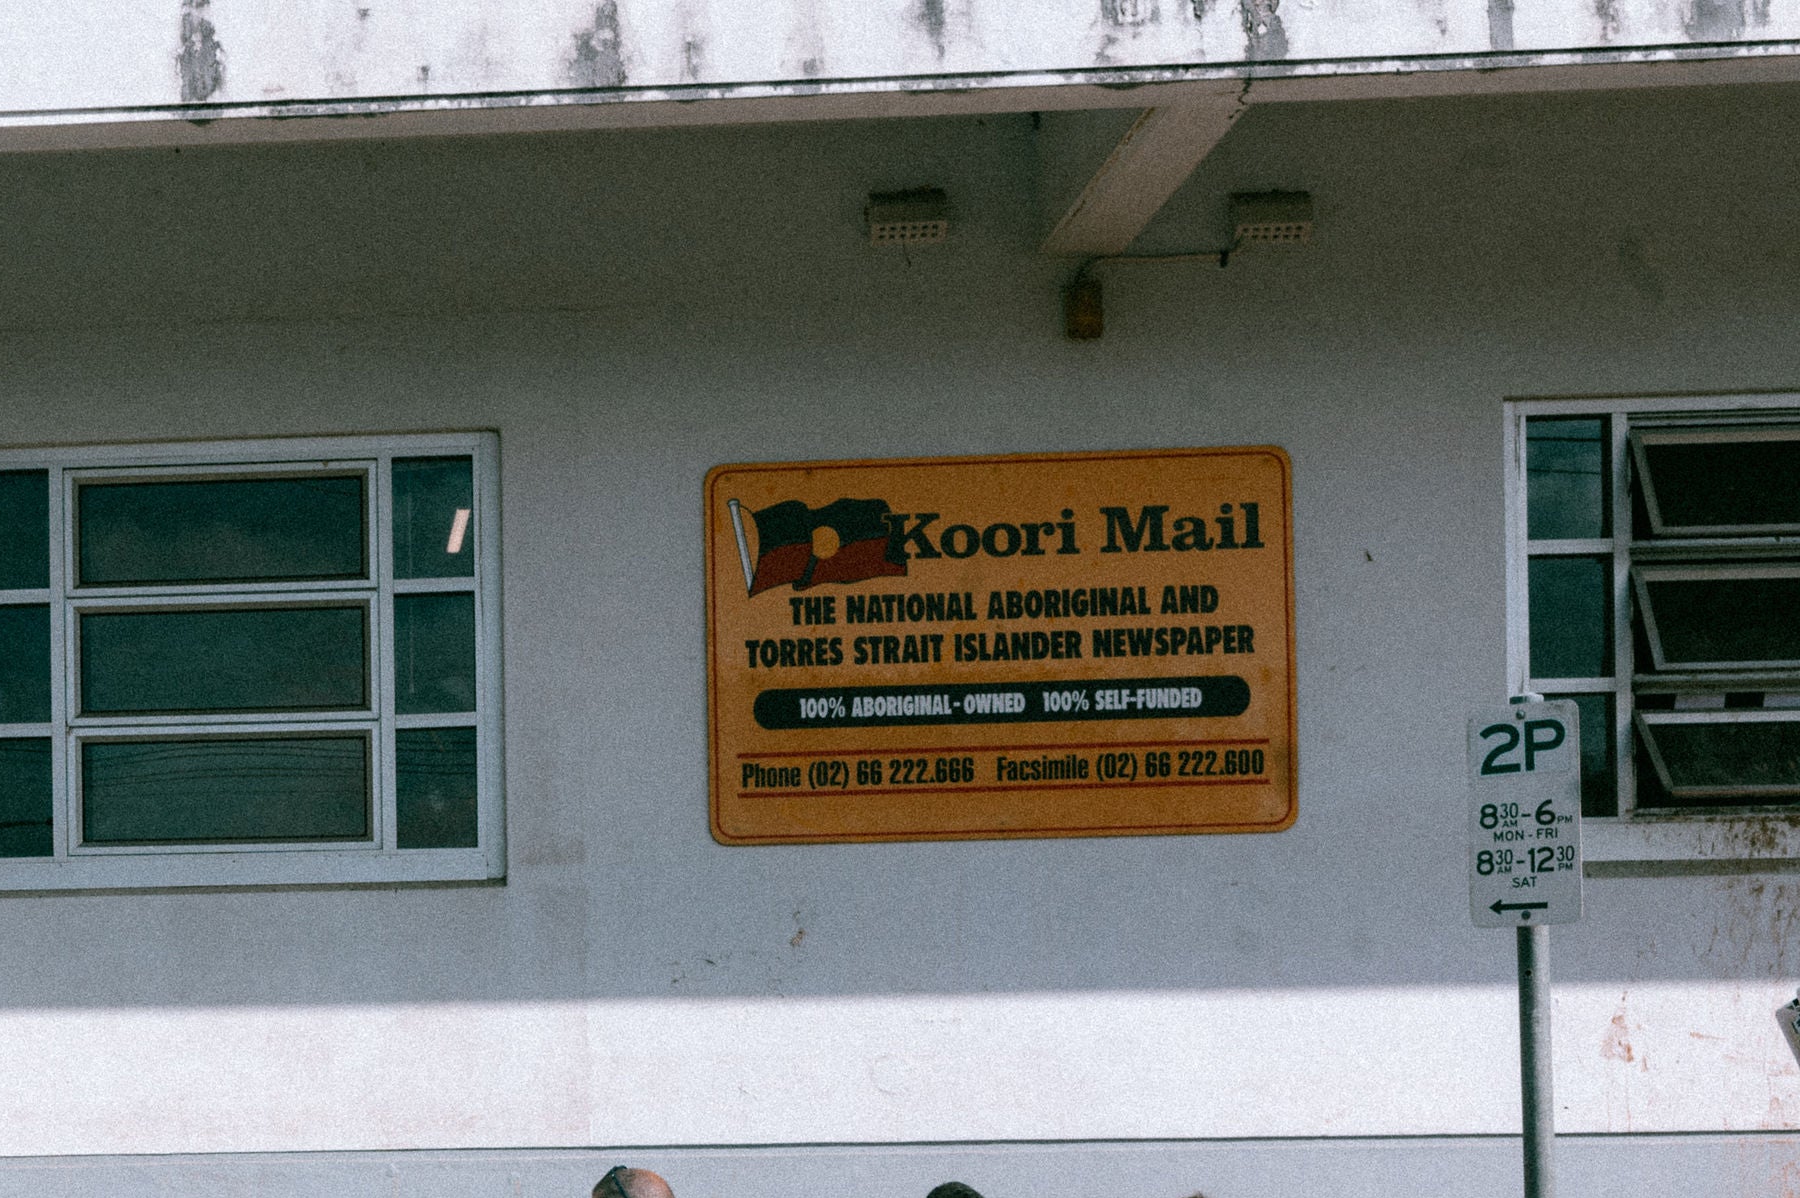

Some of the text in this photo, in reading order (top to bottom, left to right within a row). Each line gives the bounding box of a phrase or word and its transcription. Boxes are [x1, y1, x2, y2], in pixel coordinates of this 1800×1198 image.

[883, 502, 1265, 561] Koori Mail
[789, 584, 1219, 627] THE NATIONAL ABORIGINAL AND
[745, 624, 1255, 669] TORRES STRAIT ISLANDER NEWSPAPER
[799, 695, 846, 719] 100%
[1042, 690, 1090, 714] 100%
[1094, 686, 1203, 711] SELF-FUNDED
[1479, 718, 1566, 775] 2P
[741, 748, 1265, 790] Phone (02) 66 222.666 Facsimile (02) 66 222.600
[1512, 876, 1538, 888] SAT
